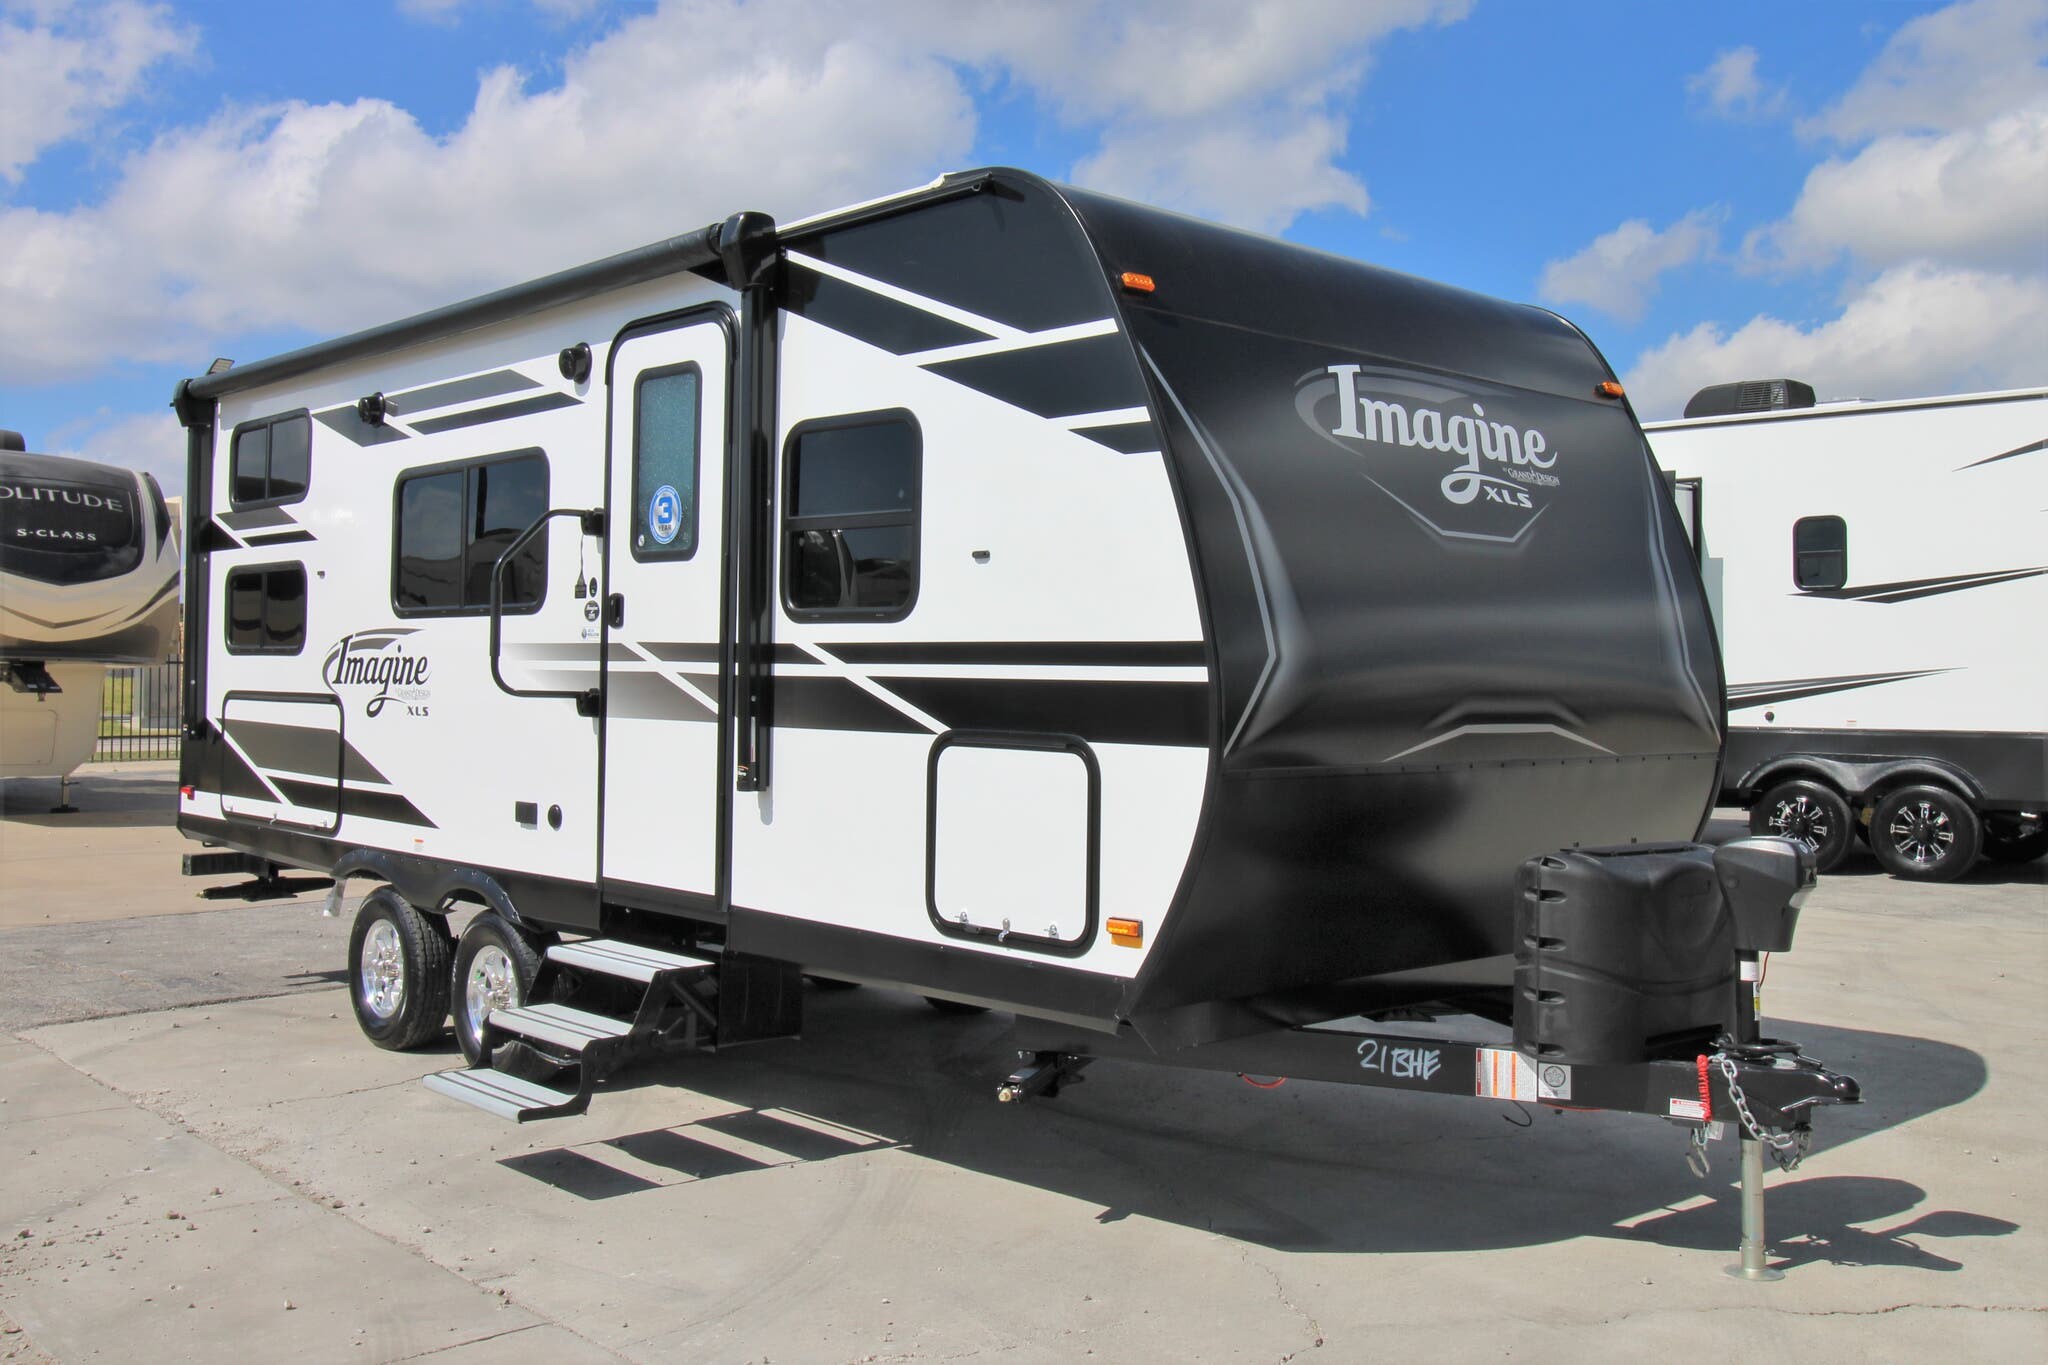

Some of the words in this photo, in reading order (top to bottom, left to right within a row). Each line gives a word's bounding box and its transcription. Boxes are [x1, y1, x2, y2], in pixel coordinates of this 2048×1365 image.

[1328, 364, 1558, 504] Imagine
[0, 486, 123, 512] OLITUDE
[1483, 485, 1533, 508] XLS
[658, 496, 673, 524] 3
[16, 528, 97, 541] S-CLASS
[332, 633, 430, 718] Imagine
[407, 706, 429, 716] XLS
